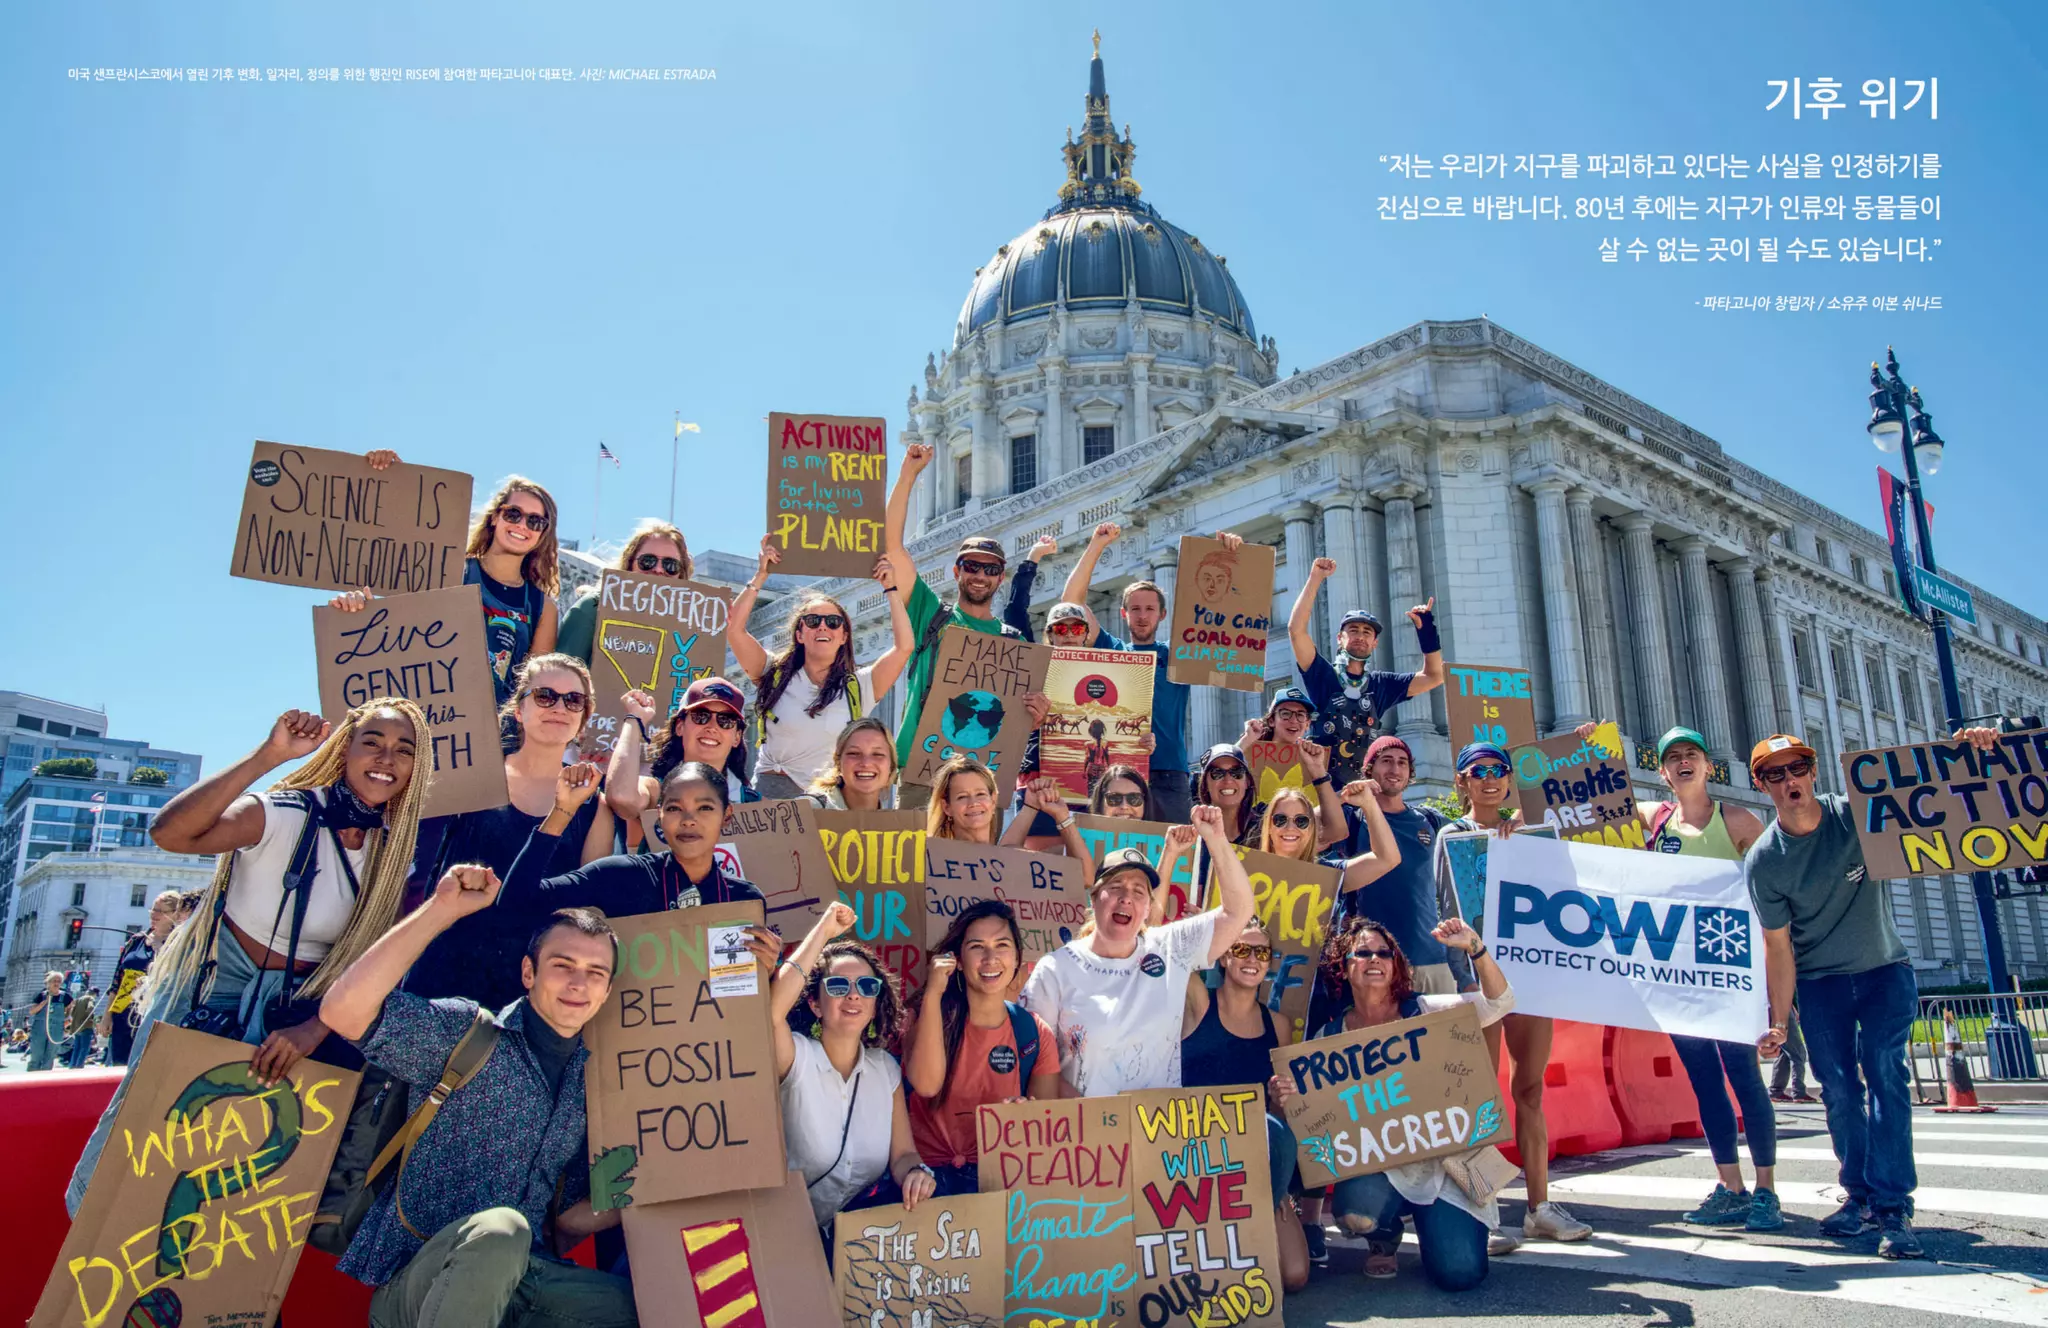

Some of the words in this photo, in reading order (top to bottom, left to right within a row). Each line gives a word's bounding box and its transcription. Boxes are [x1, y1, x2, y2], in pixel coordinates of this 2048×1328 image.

[781, 418, 883, 453] ACTIVISM
[828, 451, 886, 482] RENT
[416, 474, 448, 530] IS
[778, 478, 806, 497] for
[812, 479, 864, 508] living
[773, 513, 885, 553] PLANET
[602, 574, 729, 636] REGISTERED
[1920, 575, 1970, 615] McAllister
[334, 608, 459, 665] Live
[603, 636, 656, 656] NEVADA
[960, 634, 1032, 673] MAKE
[1051, 650, 1089, 661] ROTECT
[1091, 652, 1110, 663] THE
[1112, 653, 1152, 664] SACRED
[942, 657, 1031, 697] EARTH
[1450, 667, 1532, 699] THERE
[1473, 723, 1509, 747] NO
[1482, 699, 1499, 719] is
[1517, 739, 1610, 782] Climate
[1541, 762, 1628, 806] Rights
[1543, 802, 1596, 831] ARE
[1866, 775, 2048, 834] ACTIO
[818, 828, 927, 885] ROTECT
[926, 847, 1005, 883] LET'S
[1029, 860, 1064, 892] BE
[1497, 880, 1688, 962] POW
[1495, 944, 1596, 971] PROTECT
[1600, 957, 1647, 980] OUR
[1650, 965, 1753, 992] WINTERS
[620, 984, 677, 1029] BE
[689, 979, 724, 1024] A
[617, 1039, 757, 1091] FOSSIL
[1288, 1026, 1428, 1096] PROTECT
[1135, 1090, 1258, 1143] WHAT
[1337, 1071, 1412, 1122] THE
[124, 1077, 343, 1179] WHAT'S
[636, 1099, 749, 1156] FOOL
[979, 1102, 1084, 1156] Denial
[1102, 1110, 1118, 1128] is
[1332, 1105, 1471, 1168] SACRED
[185, 1145, 289, 1208] THE
[999, 1142, 1130, 1190] DEADLY
[1006, 1189, 1136, 1245] limate
[1142, 1171, 1253, 1230] WE
[68, 1191, 318, 1328] DEBATE
[861, 1220, 919, 1262] THE
[929, 1209, 981, 1261] SEA
[1135, 1223, 1259, 1281] TELL
[1003, 1244, 1139, 1321] hange
[1111, 1295, 1126, 1317] is
[1138, 1272, 1220, 1328] OUR
